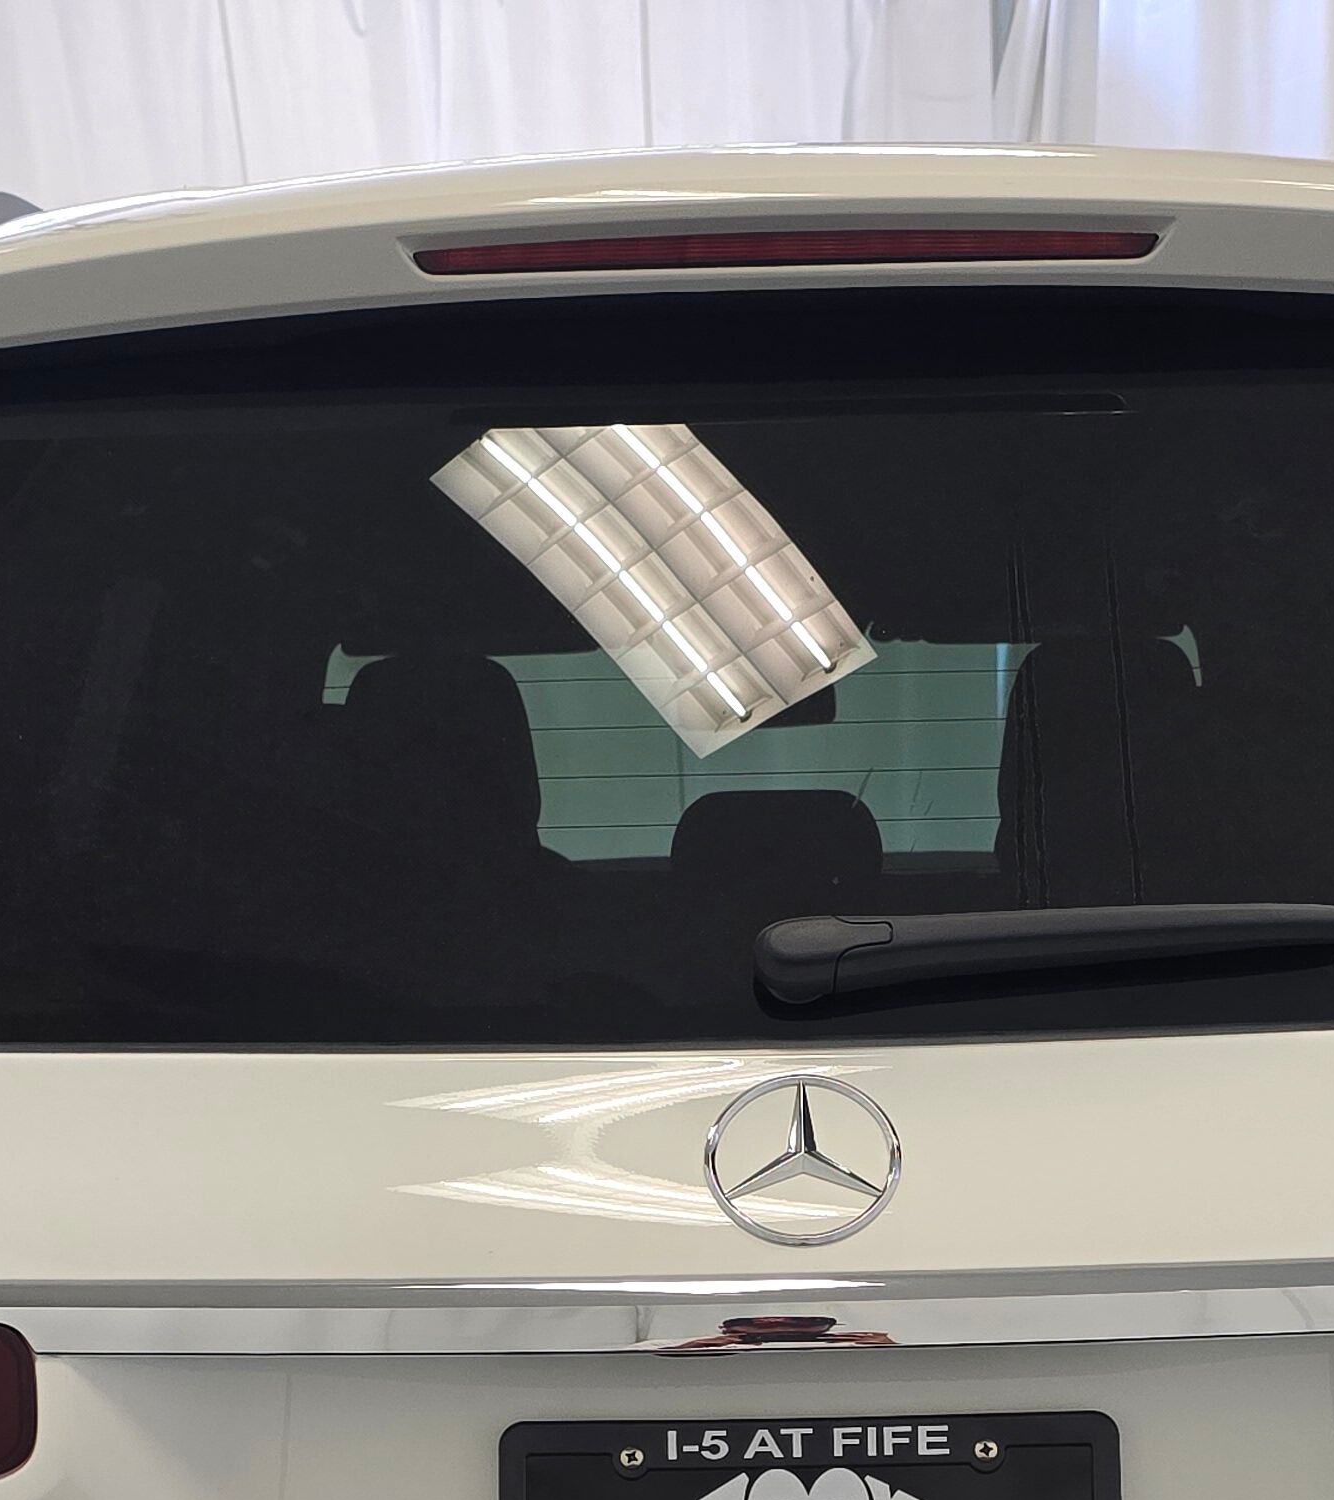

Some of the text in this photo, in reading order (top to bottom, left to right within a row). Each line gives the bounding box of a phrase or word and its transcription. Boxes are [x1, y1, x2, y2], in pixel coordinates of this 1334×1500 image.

[667, 1424, 951, 1461] I-5 AT FIFE
